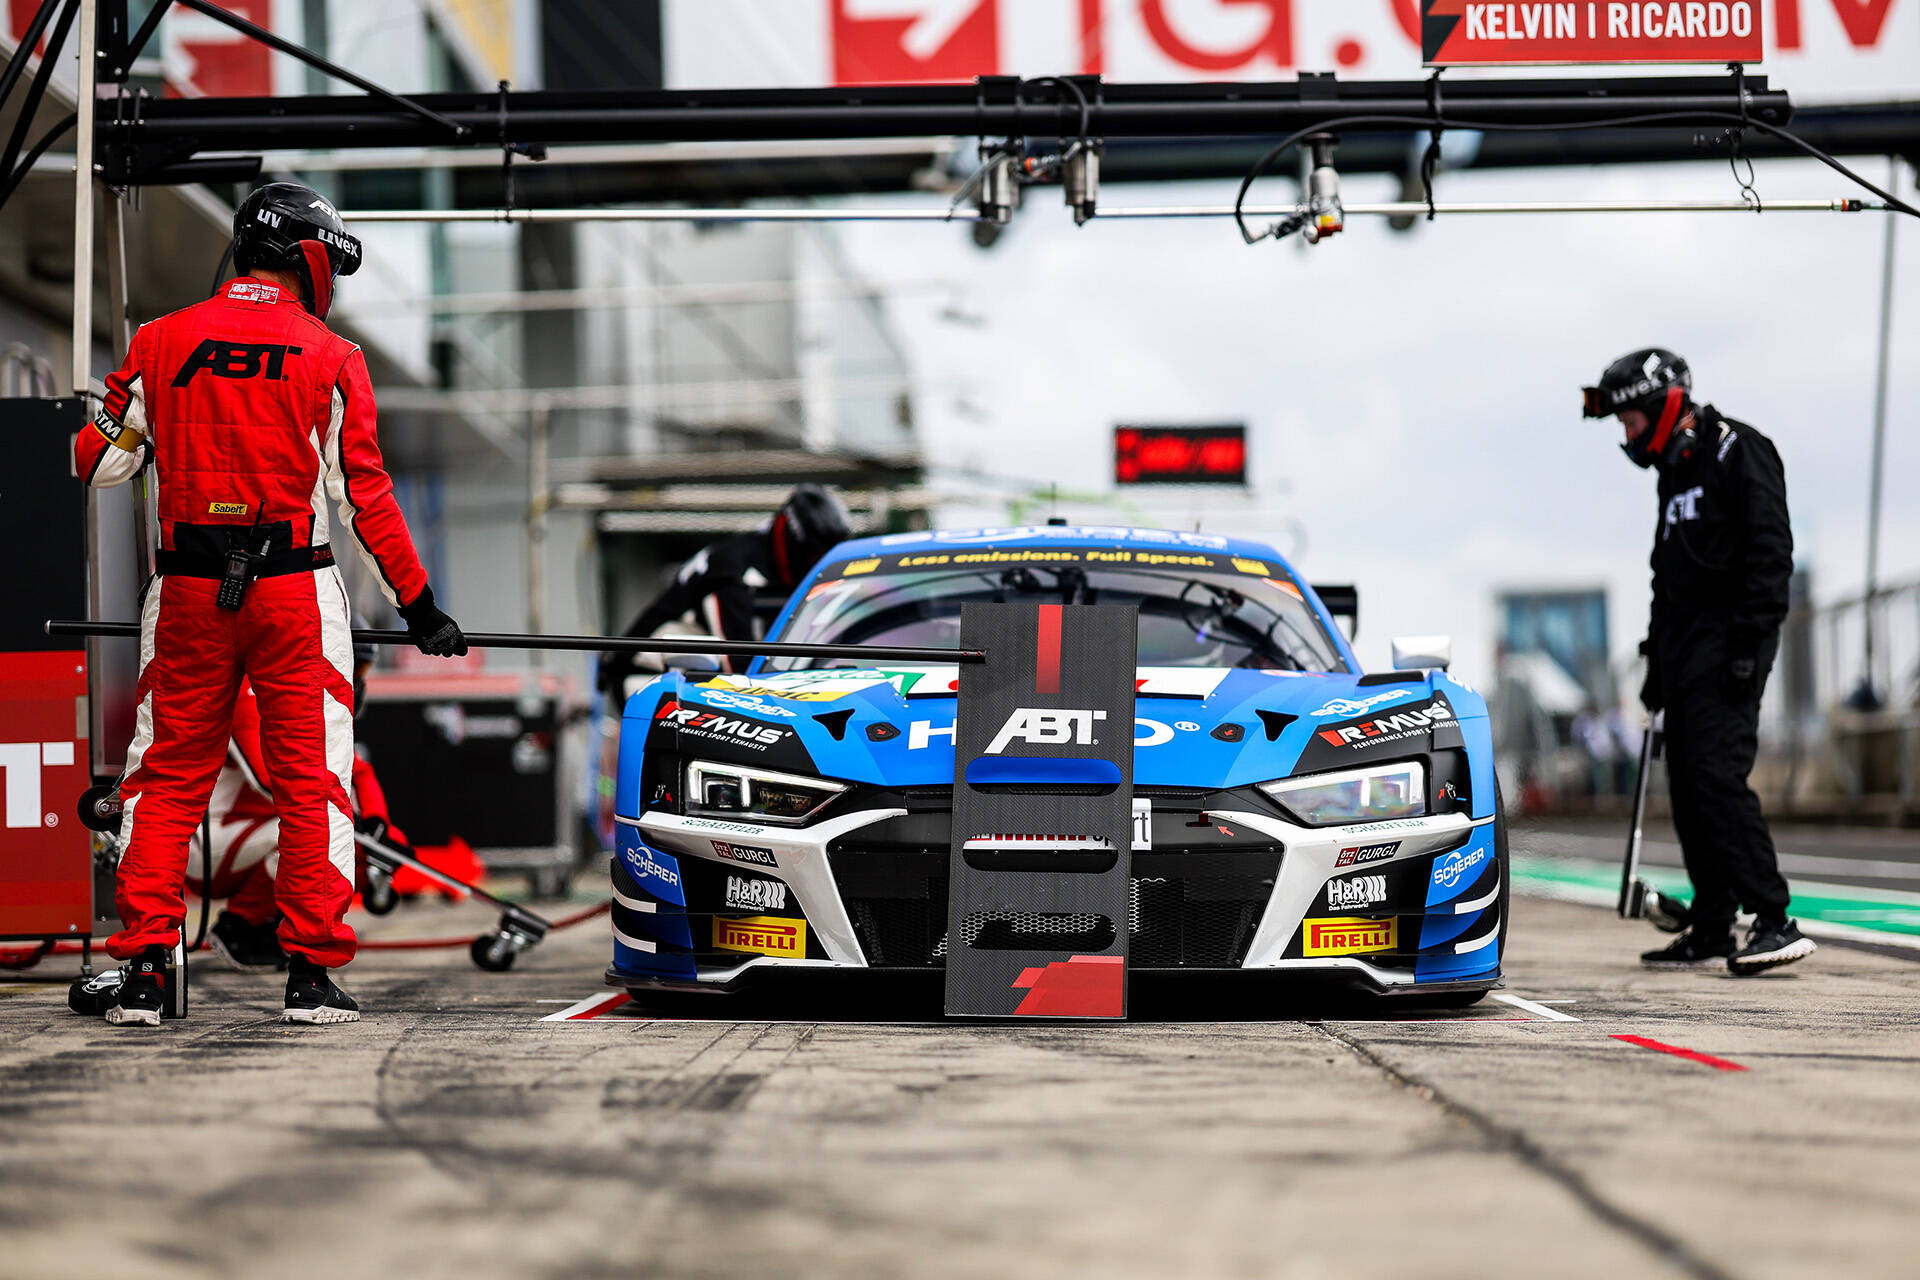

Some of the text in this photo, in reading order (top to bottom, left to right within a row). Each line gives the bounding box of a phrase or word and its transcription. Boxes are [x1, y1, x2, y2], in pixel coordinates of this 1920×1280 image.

[1465, 2, 1577, 40] KELVIN
[1607, 1, 1751, 38] RICARDO
[317, 228, 359, 258] uvex
[897, 550, 1214, 567] Less emissions. Full Speed.
[664, 707, 784, 745] REMUS
[984, 707, 1107, 754] ABT
[1337, 700, 1452, 744] REMUS
[707, 731, 730, 742] SPORT
[730, 737, 768, 752] EXHAUSTS
[1352, 733, 1403, 750] PERFORMANCE
[1402, 728, 1423, 738] SPORT
[626, 847, 678, 887] SCHERER
[732, 847, 776, 865] GURGL
[1357, 844, 1396, 861] GURGL
[1434, 847, 1485, 885] SCHERER
[718, 919, 797, 951] PIRELLI
[1311, 921, 1391, 949] PIRELLI
